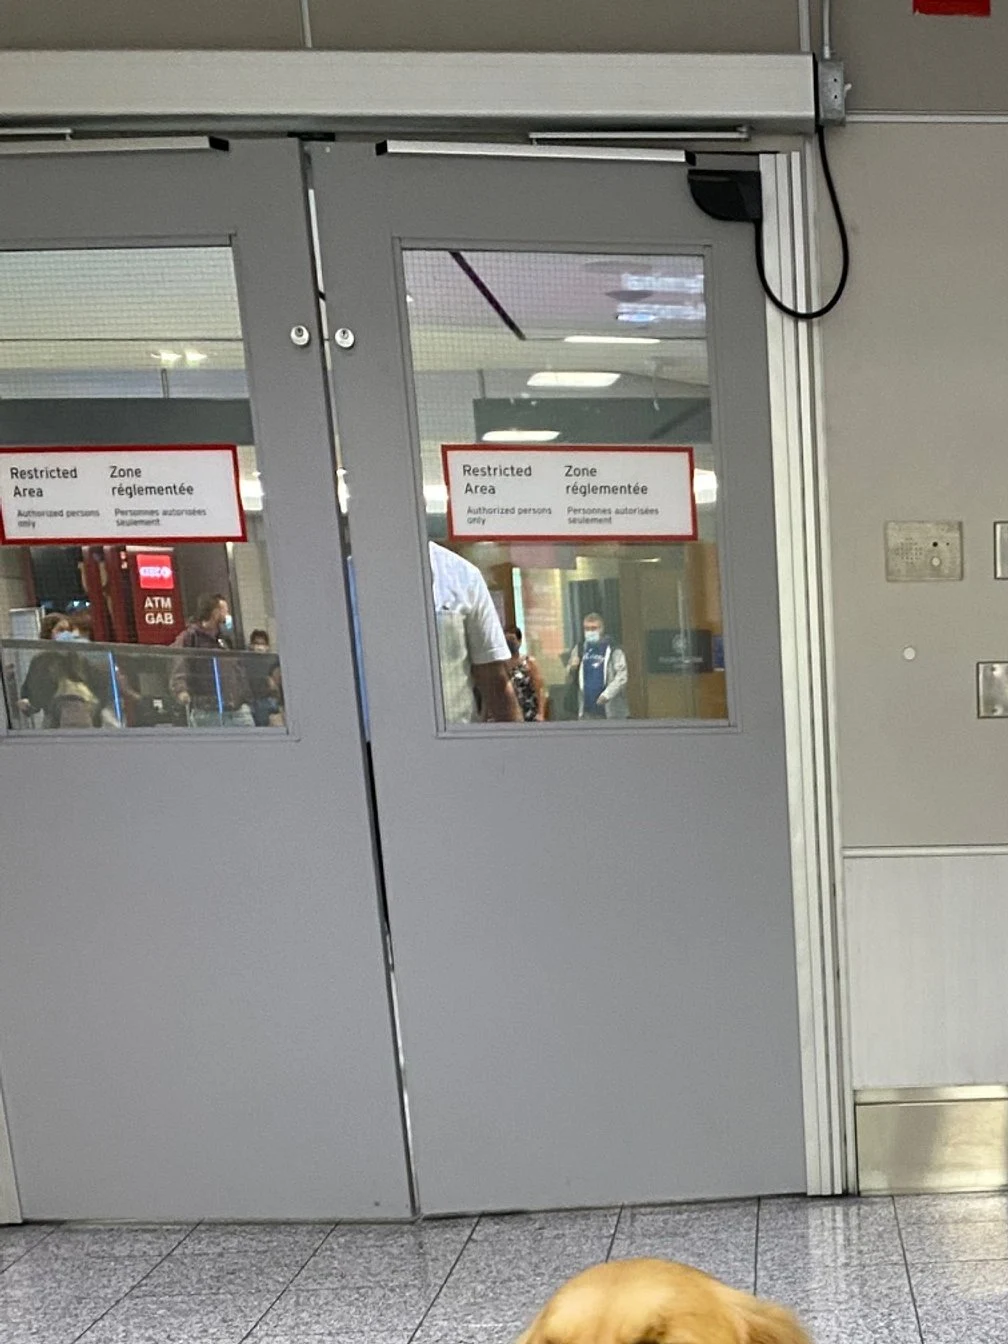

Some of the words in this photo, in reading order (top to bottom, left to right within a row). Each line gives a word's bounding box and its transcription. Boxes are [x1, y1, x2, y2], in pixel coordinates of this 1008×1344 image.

[10, 467, 78, 479] Restricted
[109, 465, 142, 478] Zone
[462, 464, 532, 477] Restricted
[564, 465, 598, 477] Zone
[13, 486, 44, 498] Area
[111, 483, 195, 499] réglementée
[464, 483, 496, 495] Area
[566, 482, 649, 498] réglementée
[144, 596, 172, 609] ATM
[145, 612, 174, 625] GAB
